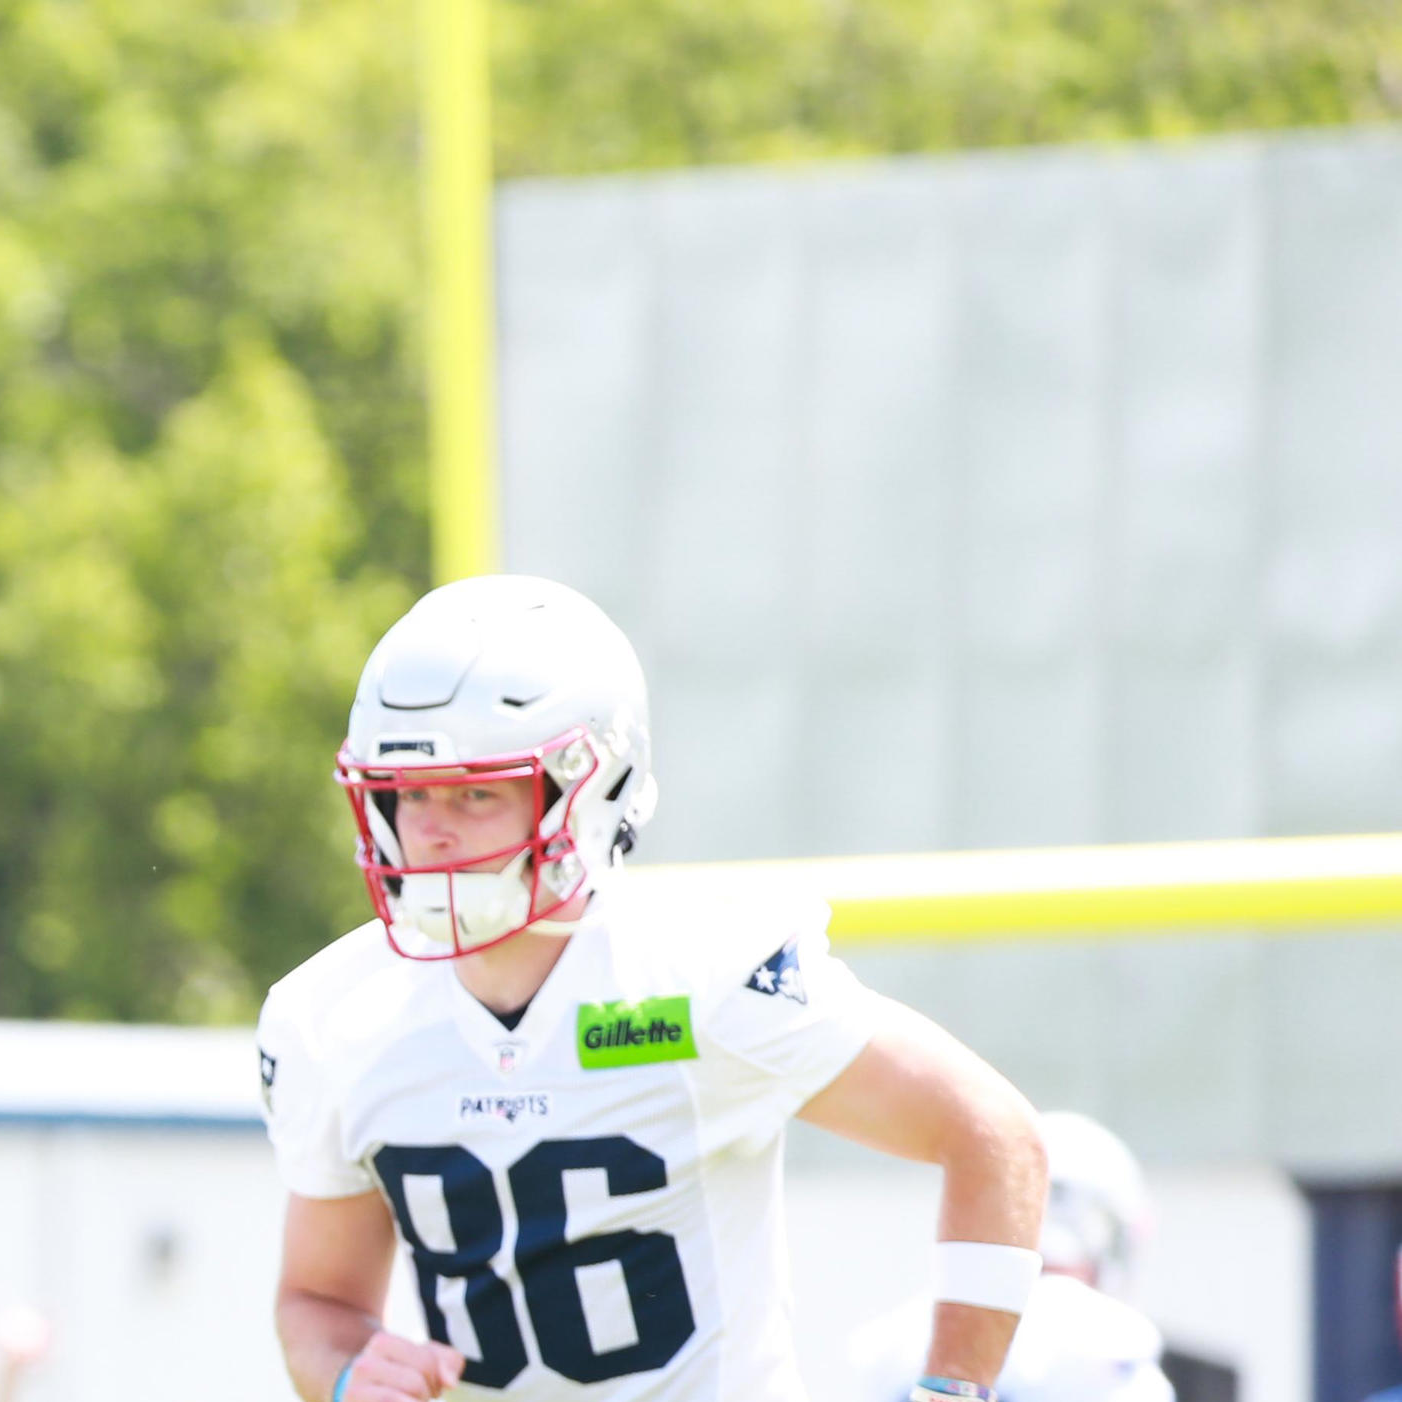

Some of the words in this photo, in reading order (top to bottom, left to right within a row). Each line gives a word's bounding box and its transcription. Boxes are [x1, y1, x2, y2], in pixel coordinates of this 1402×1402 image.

[584, 1020, 682, 1050] Gillette
[460, 1095, 548, 1116] PATRIOTS
[373, 1134, 696, 1389] 86
